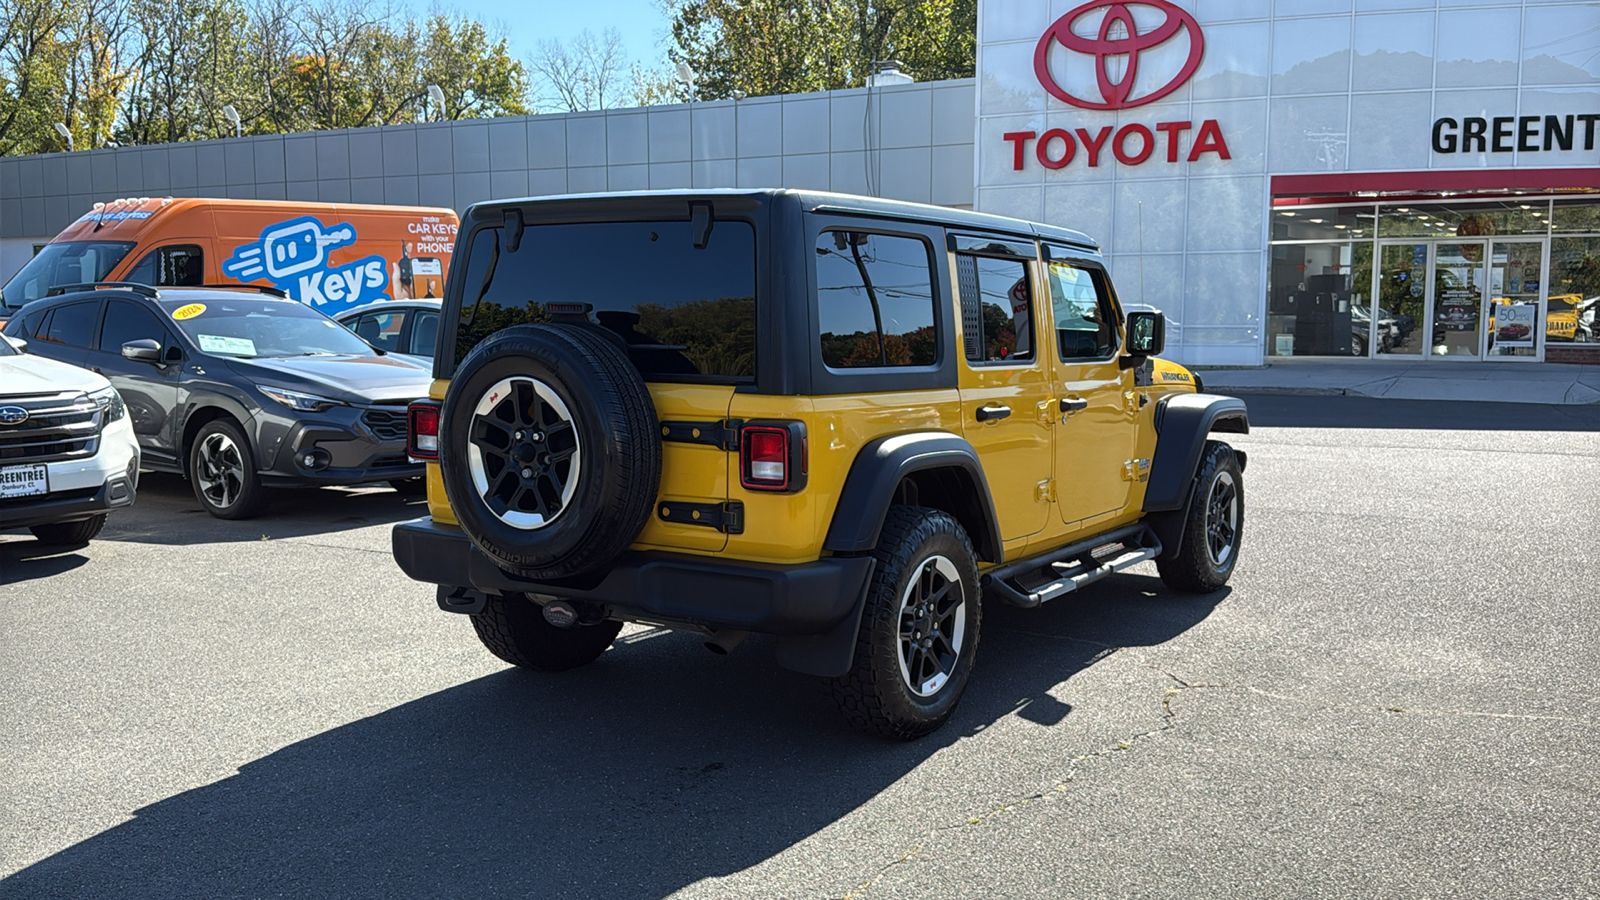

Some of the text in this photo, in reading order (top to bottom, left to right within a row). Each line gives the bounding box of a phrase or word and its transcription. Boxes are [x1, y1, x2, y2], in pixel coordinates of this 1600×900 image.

[1431, 113, 1600, 154] GREENT
[1003, 119, 1232, 170] TOYOTA
[407, 222, 458, 235] CAR KEYS
[435, 236, 449, 244] your
[298, 261, 385, 306] Keys
[177, 304, 202, 319] 2024
[1498, 308, 1516, 321] 50
[1160, 371, 1192, 383] WRANGLER
[2, 483, 27, 491] Danbury,
[481, 538, 537, 564] MICHELIN
